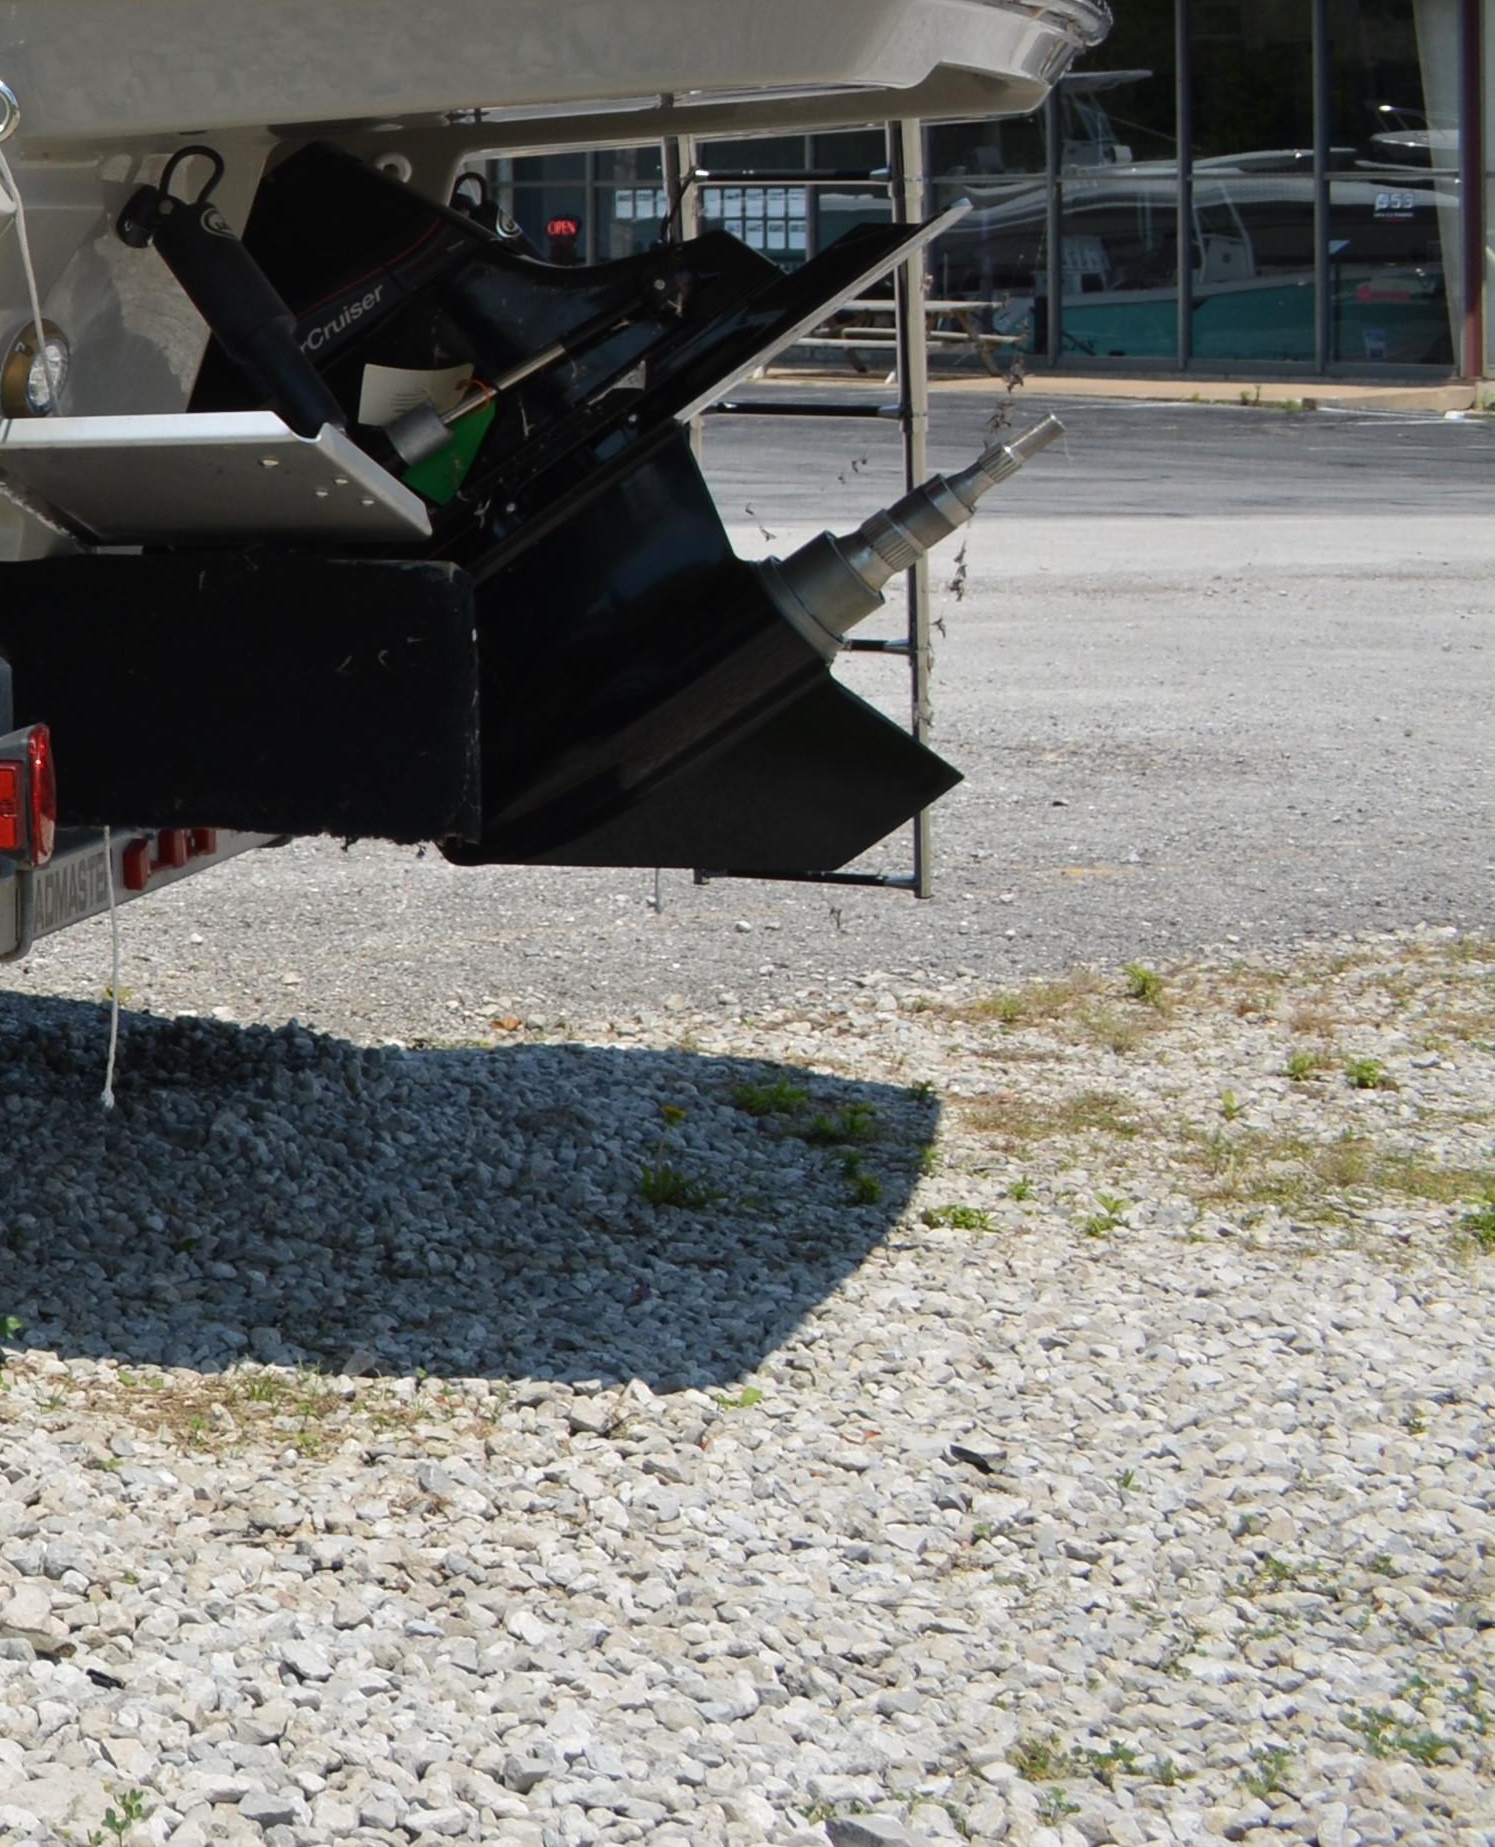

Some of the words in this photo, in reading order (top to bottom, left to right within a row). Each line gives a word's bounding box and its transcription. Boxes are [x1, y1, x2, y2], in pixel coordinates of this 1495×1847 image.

[547, 219, 576, 235] OPEN
[299, 283, 384, 355] rCruiser
[34, 851, 108, 934] ADMASTE
